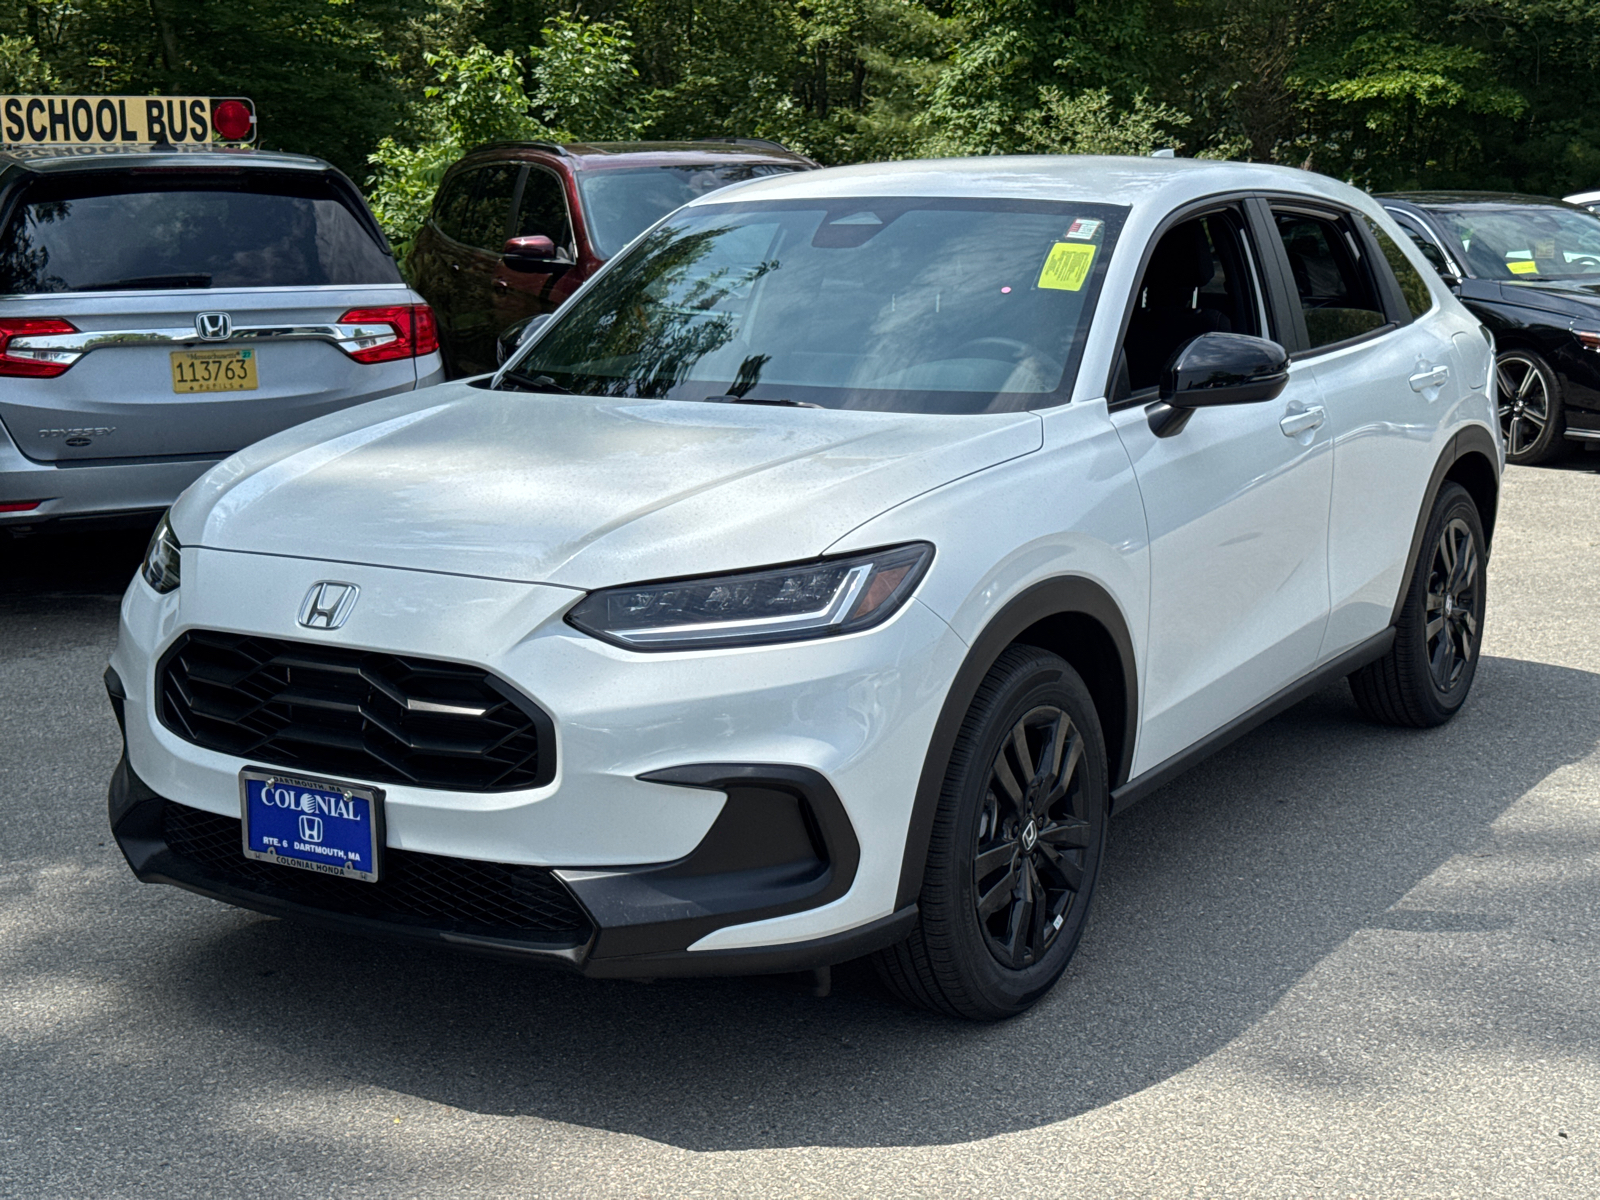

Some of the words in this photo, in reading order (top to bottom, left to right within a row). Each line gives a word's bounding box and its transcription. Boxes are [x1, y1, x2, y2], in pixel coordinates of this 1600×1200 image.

[4, 98, 138, 142] SCHOOL
[145, 99, 208, 142] BUS
[176, 359, 248, 383] 113763
[39, 426, 117, 438] ODYSSEY
[273, 775, 327, 791] DARTMOUTH,
[328, 785, 342, 793] MA
[261, 785, 361, 821] COLONIAL
[262, 836, 281, 847] RTE.
[282, 840, 289, 848] 6
[293, 841, 347, 860] DARTMOUTH,
[347, 851, 361, 862] MA
[276, 855, 315, 871] COLONIAL
[316, 863, 345, 876] HONDA
